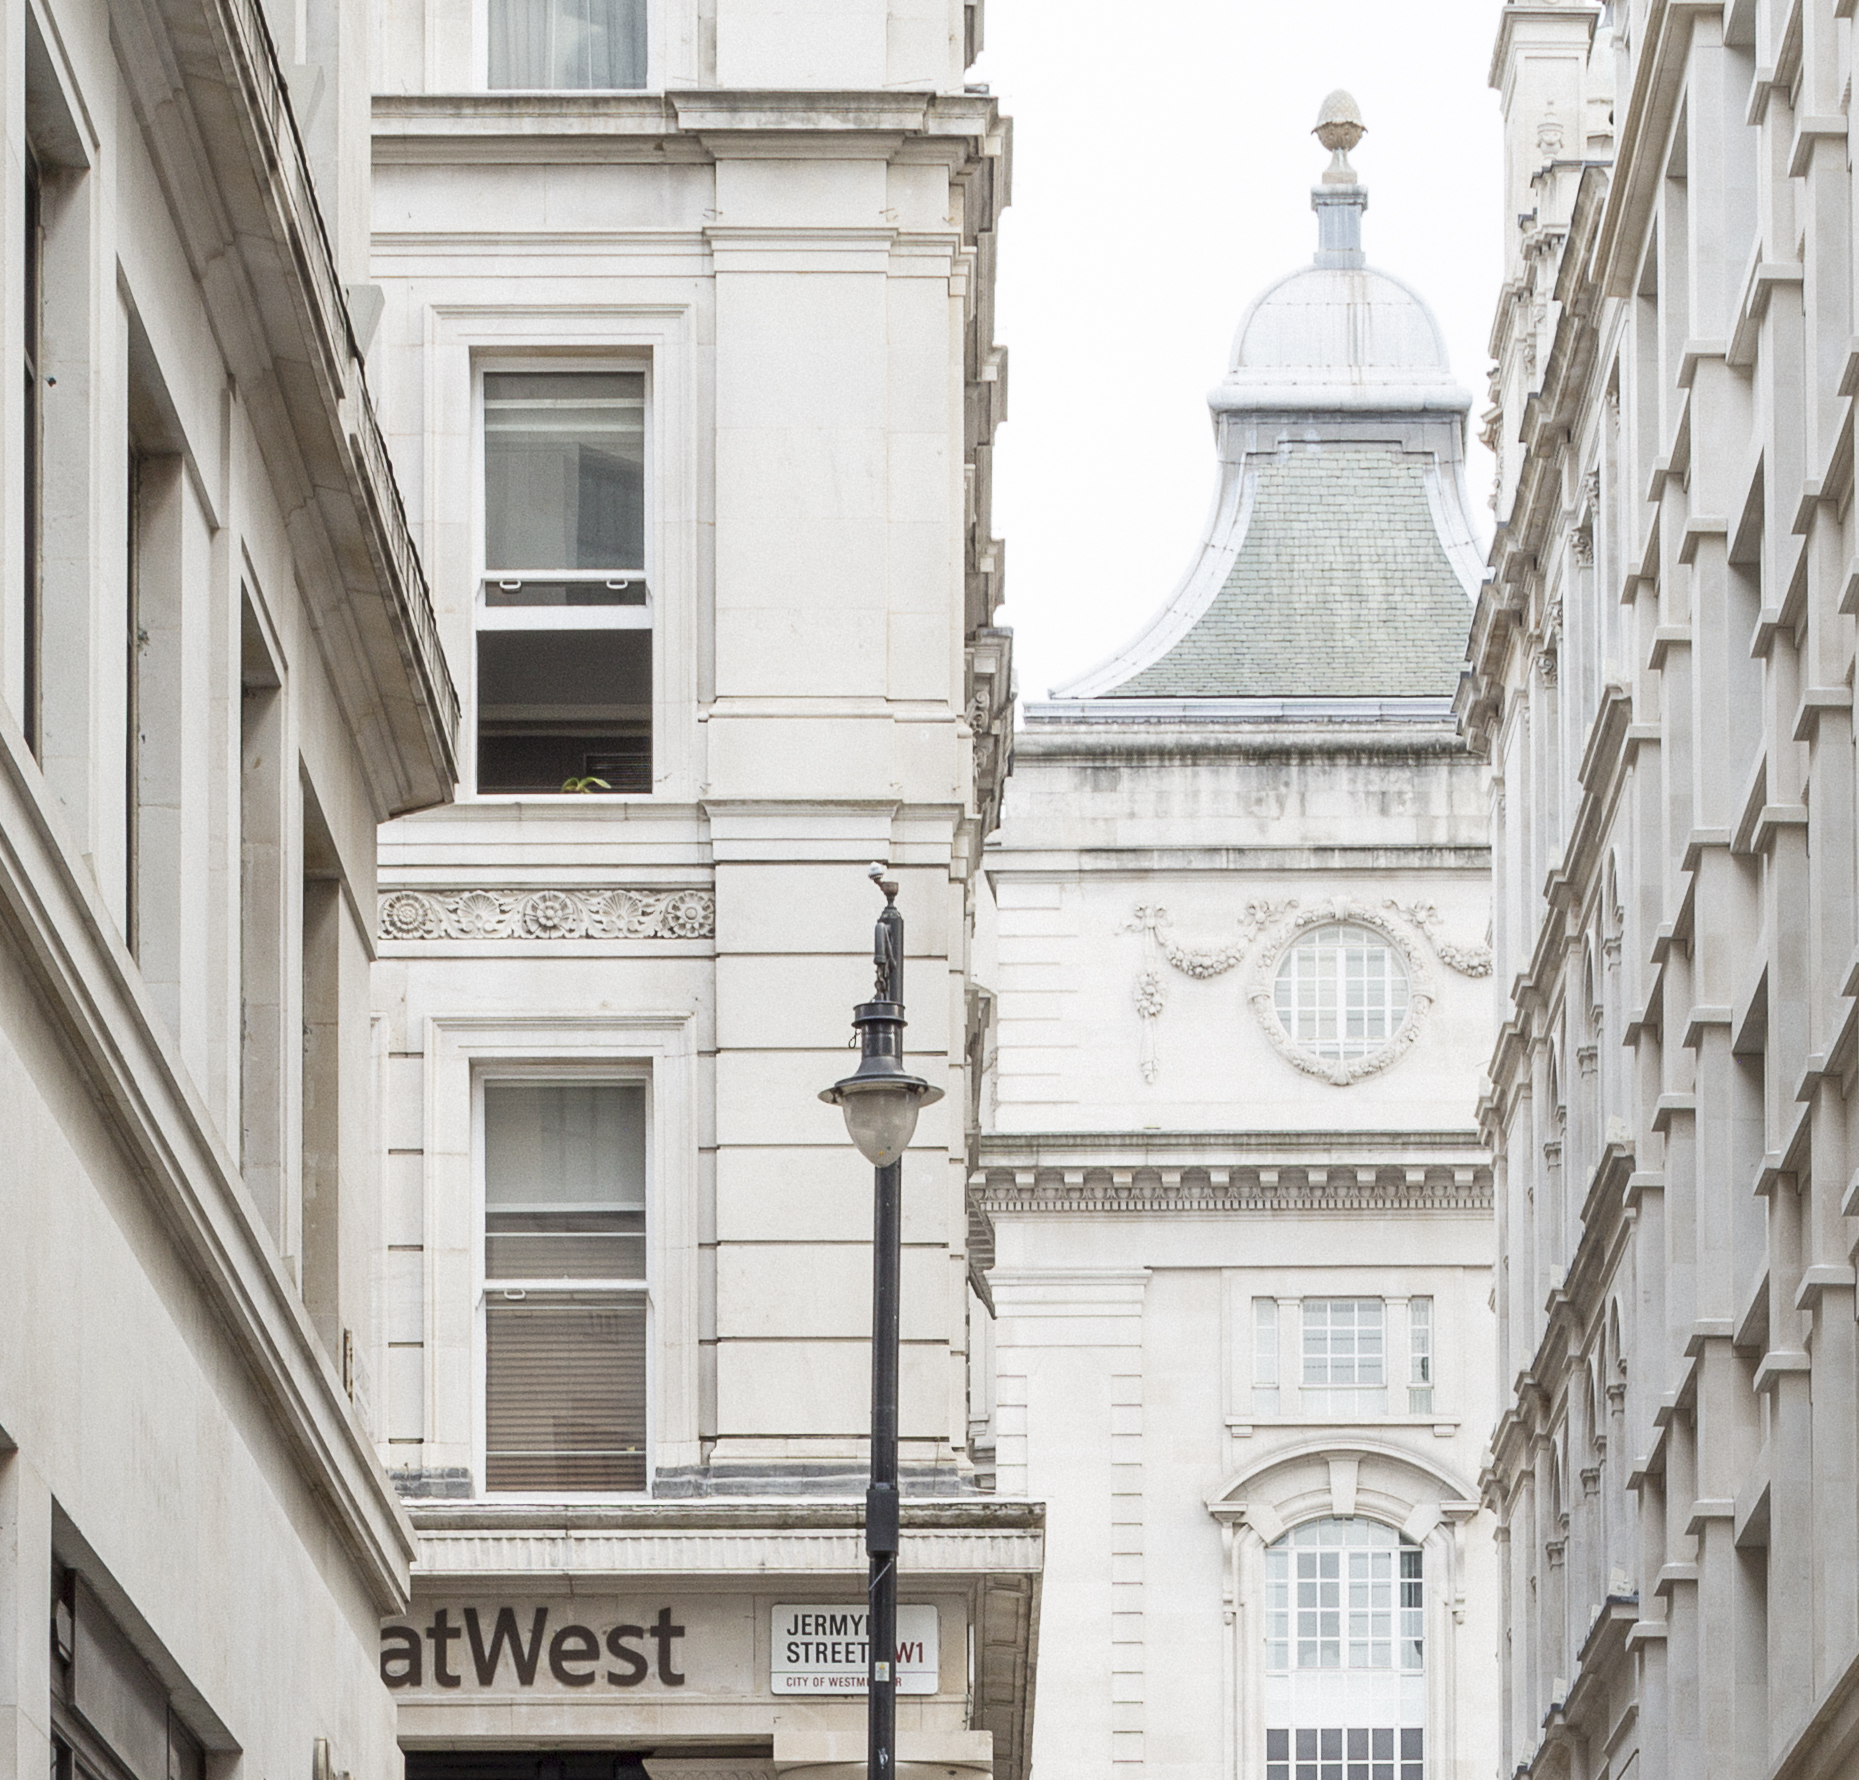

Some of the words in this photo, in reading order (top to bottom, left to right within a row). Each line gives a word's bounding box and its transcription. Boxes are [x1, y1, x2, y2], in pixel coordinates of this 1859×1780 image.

[786, 1614, 869, 1636] JERMY
[786, 1641, 870, 1664] STREET
[786, 1677, 809, 1687] CITY
[813, 1677, 825, 1687] OF
